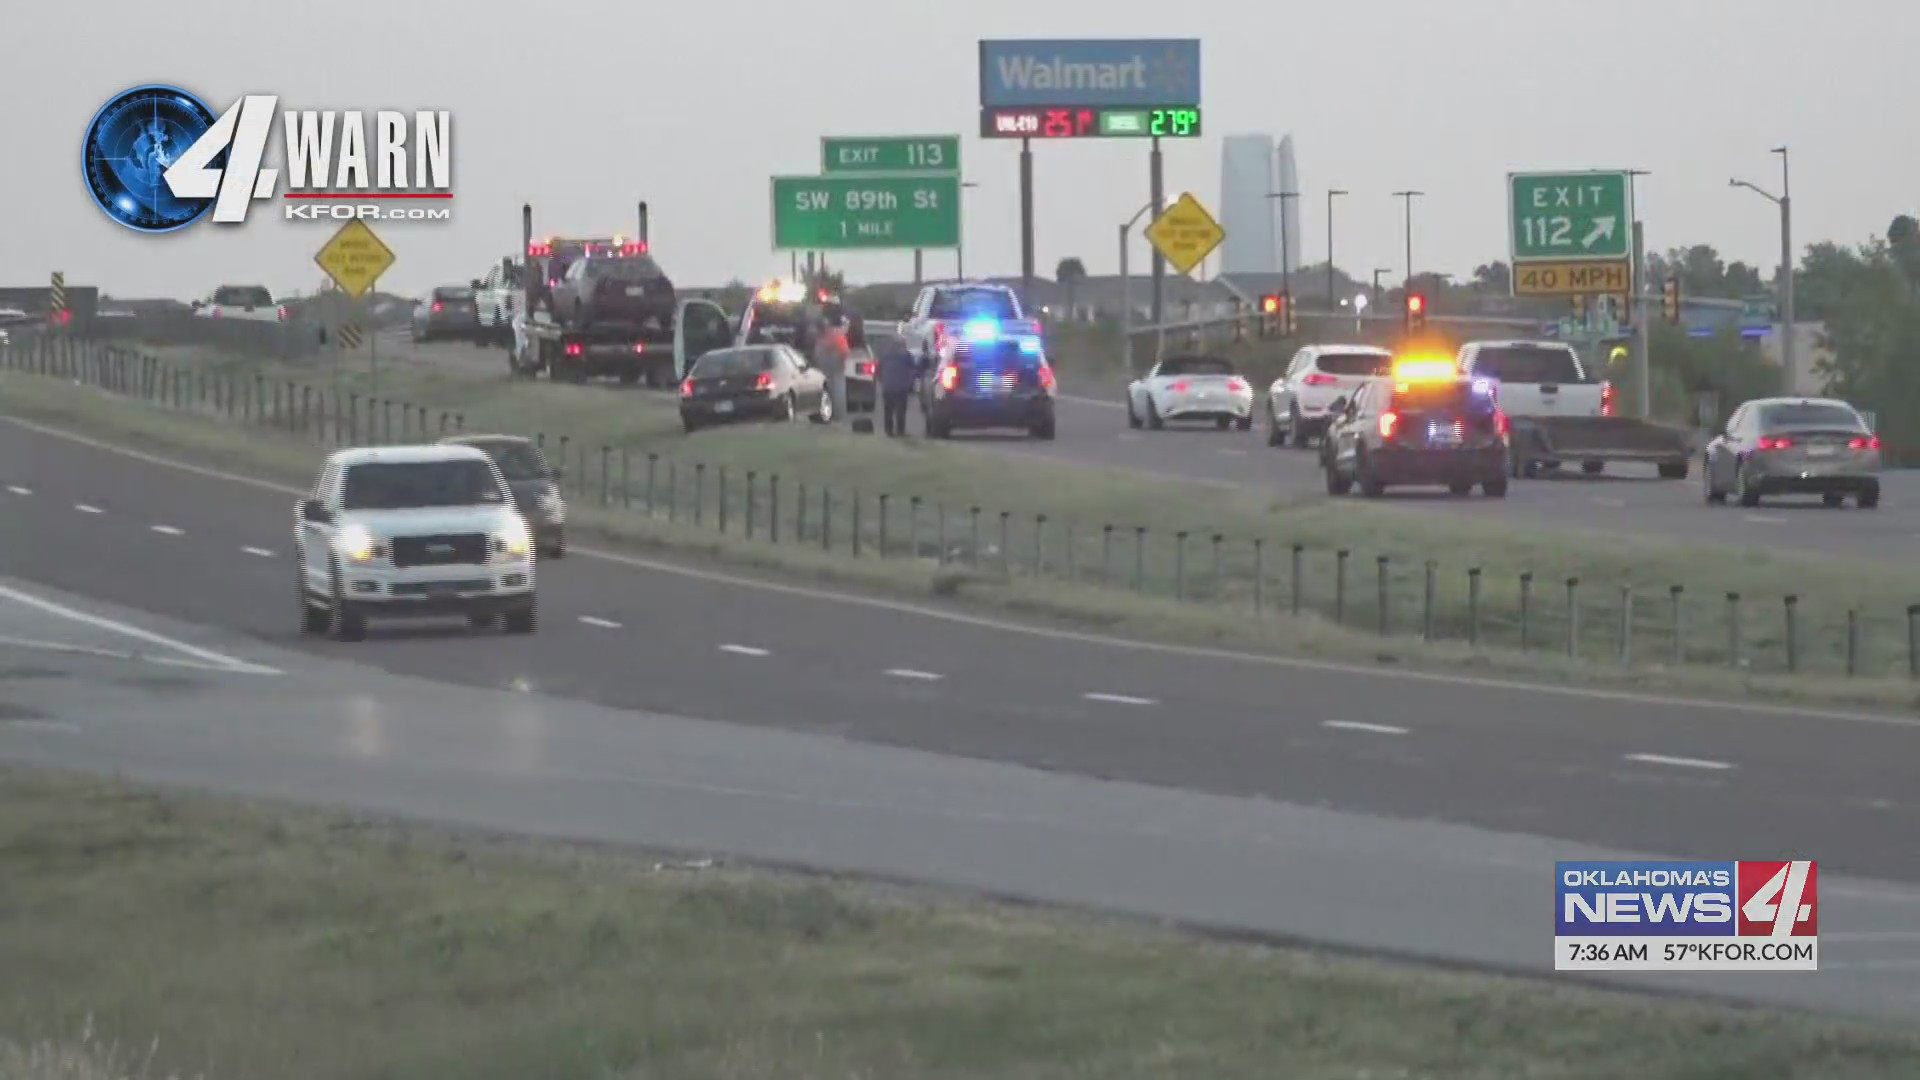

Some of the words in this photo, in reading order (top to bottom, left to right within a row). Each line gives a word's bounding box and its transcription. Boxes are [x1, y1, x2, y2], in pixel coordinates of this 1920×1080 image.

[998, 55, 1147, 89] Walmart
[839, 148, 880, 164] EXIT
[907, 144, 943, 164] 113
[796, 191, 829, 210] SW
[846, 191, 898, 210] 89th
[914, 190, 938, 208] St
[1533, 186, 1604, 207] EXIT
[840, 221, 848, 237] 1
[858, 223, 893, 235] MILE
[1523, 217, 1572, 246] 112
[1521, 271, 1557, 288] 40
[1569, 268, 1622, 287] MPH
